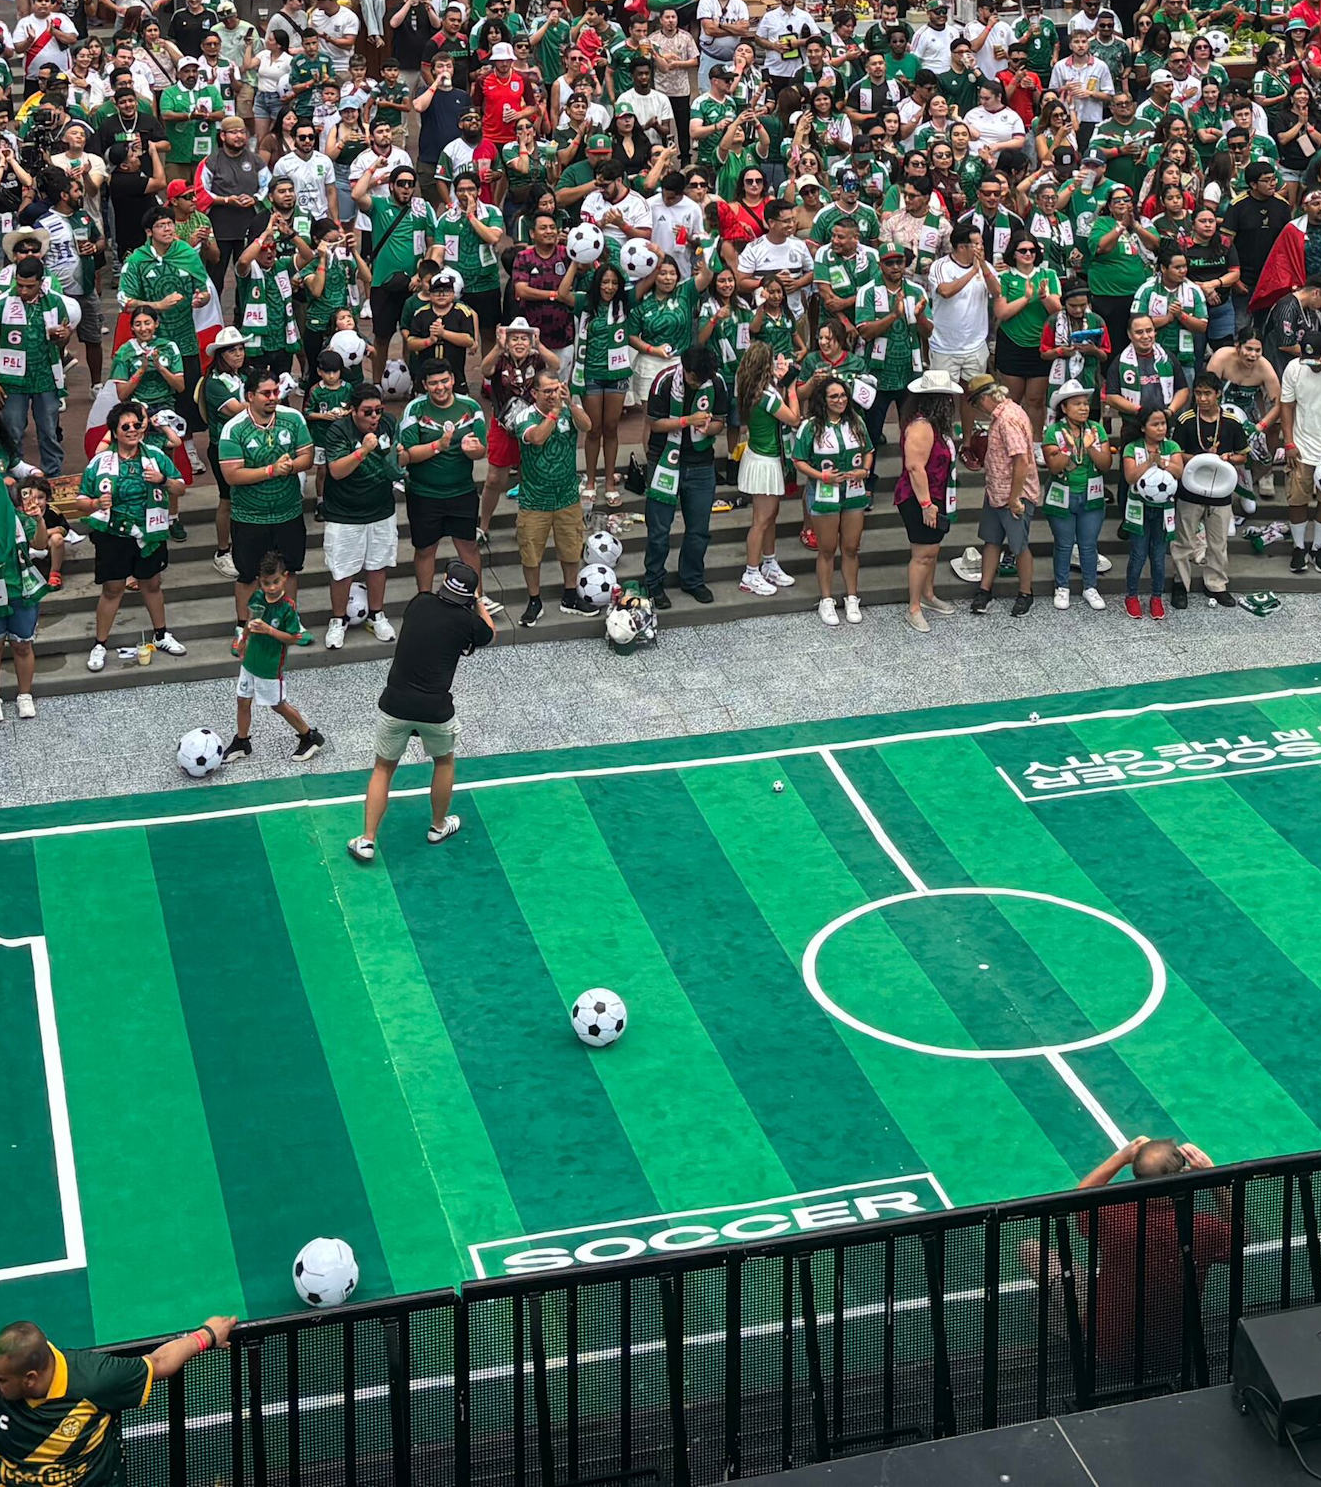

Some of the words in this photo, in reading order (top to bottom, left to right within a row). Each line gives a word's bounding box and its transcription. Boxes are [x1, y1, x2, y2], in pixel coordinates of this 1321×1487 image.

[7, 330, 22, 346] 6
[613, 328, 625, 343] 6
[2, 355, 23, 369] P&L
[611, 354, 628, 365] P&L
[1123, 369, 1136, 384] 6
[697, 395, 709, 411] 6
[851, 452, 862, 467] 6
[1271, 728, 1314, 742] IN
[1153, 734, 1268, 758] THE
[1022, 750, 1145, 776] CITY
[503, 1190, 928, 1275] SOCCER
